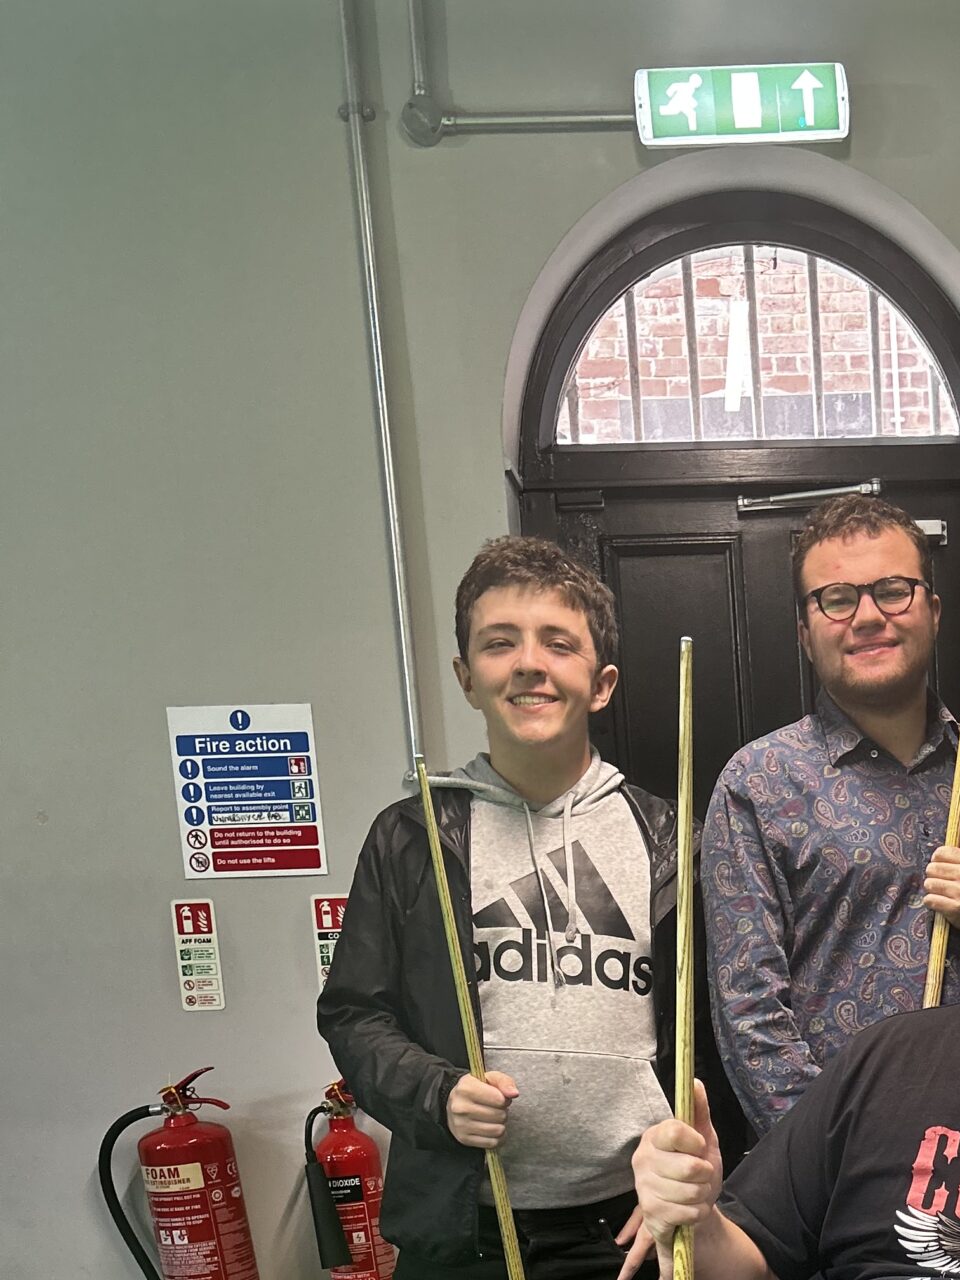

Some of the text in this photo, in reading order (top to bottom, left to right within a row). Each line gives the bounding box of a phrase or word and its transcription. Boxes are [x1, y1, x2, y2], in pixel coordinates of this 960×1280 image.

[194, 736, 291, 753] Fire action
[241, 804, 271, 812] assembly
[473, 928, 652, 996] adidas
[145, 1167, 180, 1180] FOAM
[332, 1177, 361, 1188] DIOXIDE
